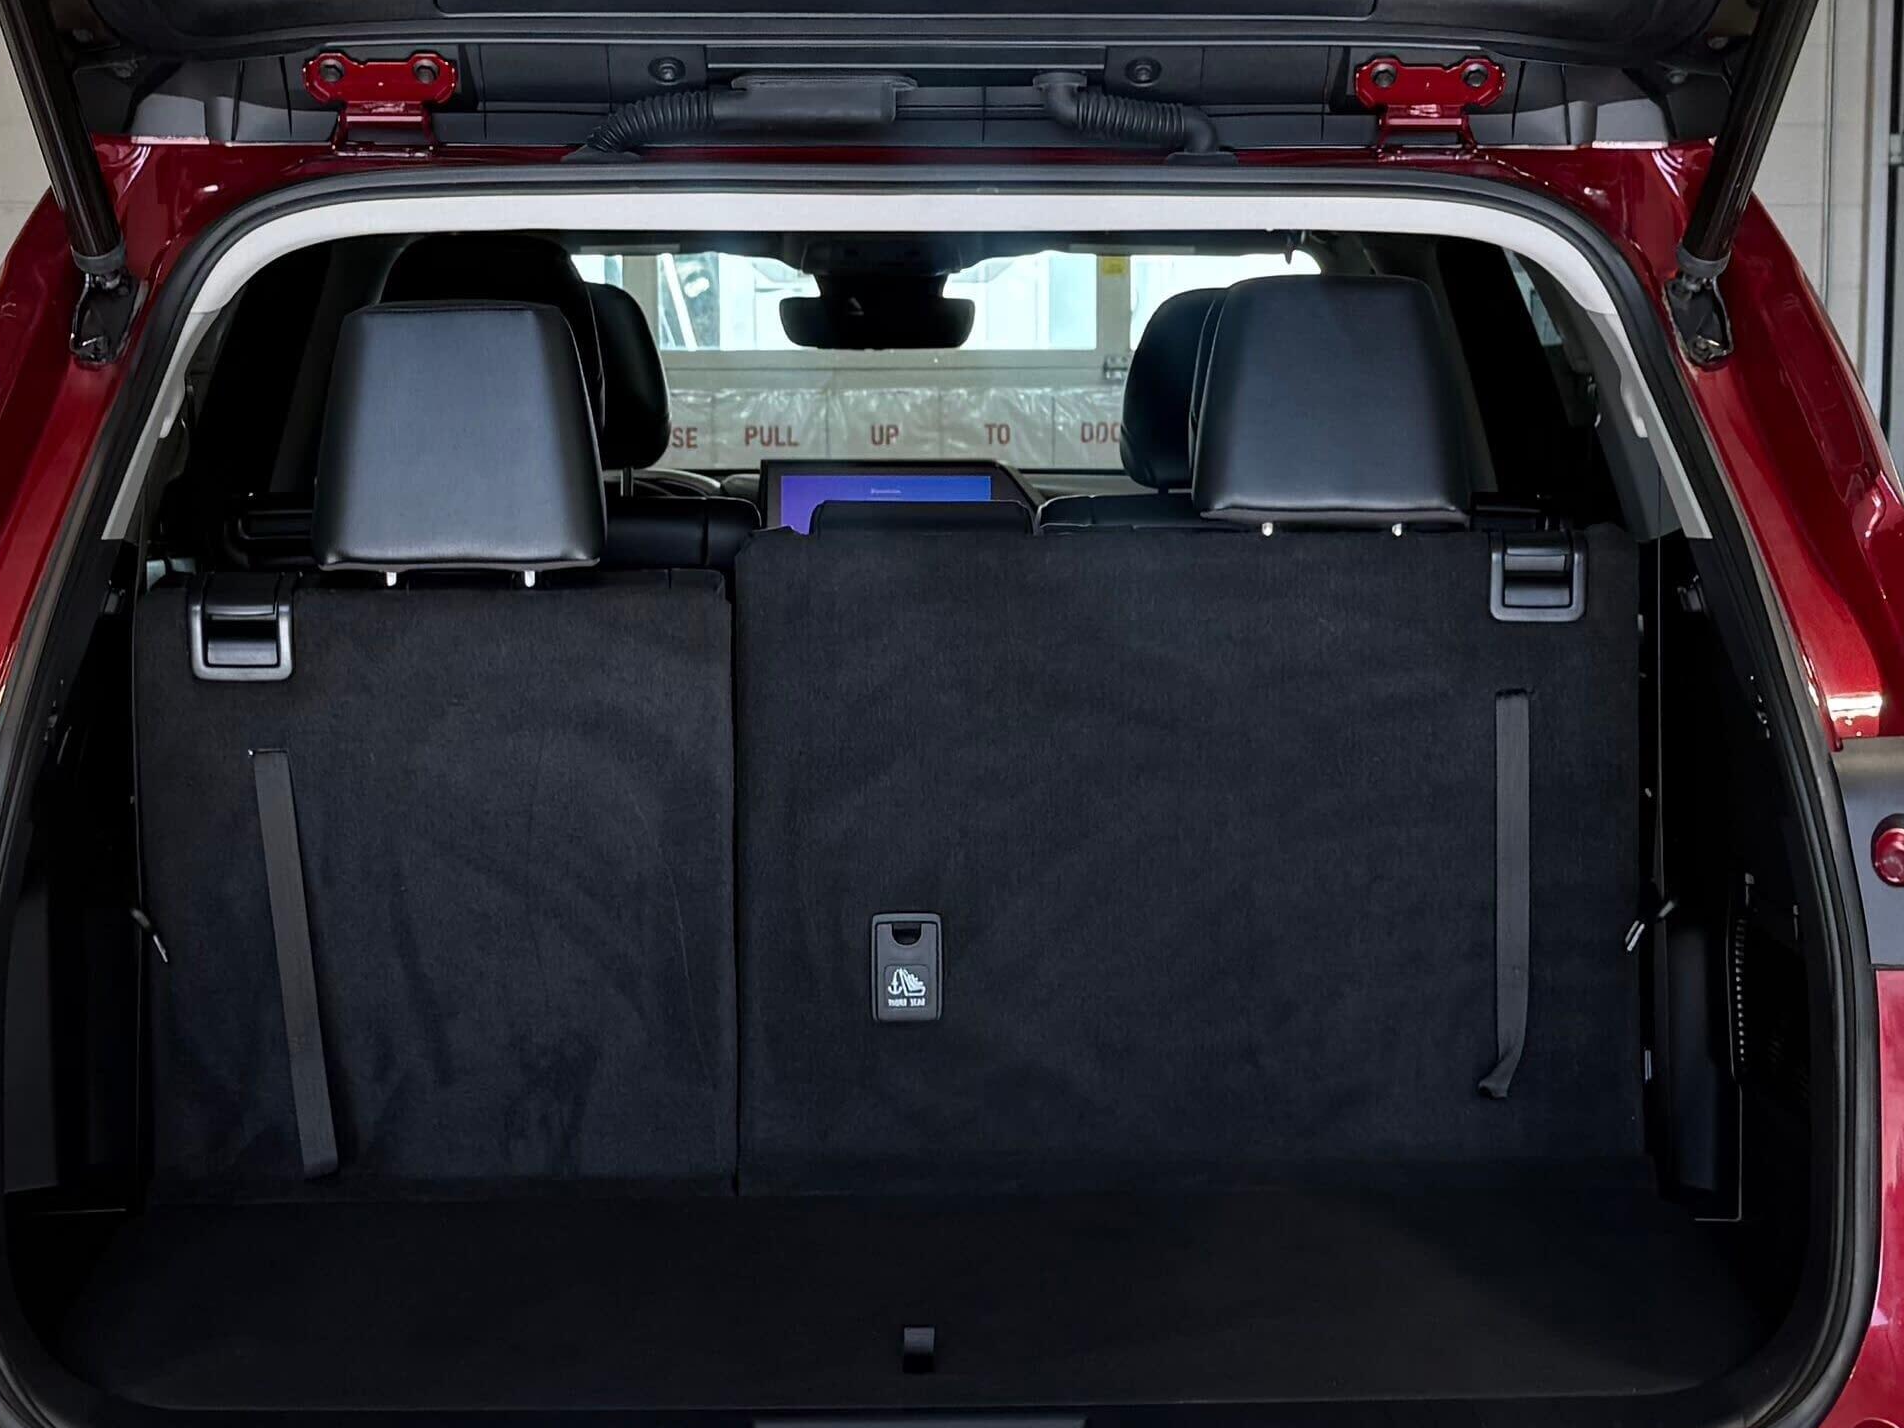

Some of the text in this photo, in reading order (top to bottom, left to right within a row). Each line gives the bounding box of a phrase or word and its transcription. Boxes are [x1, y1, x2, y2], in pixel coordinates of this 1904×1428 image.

[745, 424, 799, 448] PULL
[870, 423, 900, 446] UP
[984, 422, 1012, 445] TO
